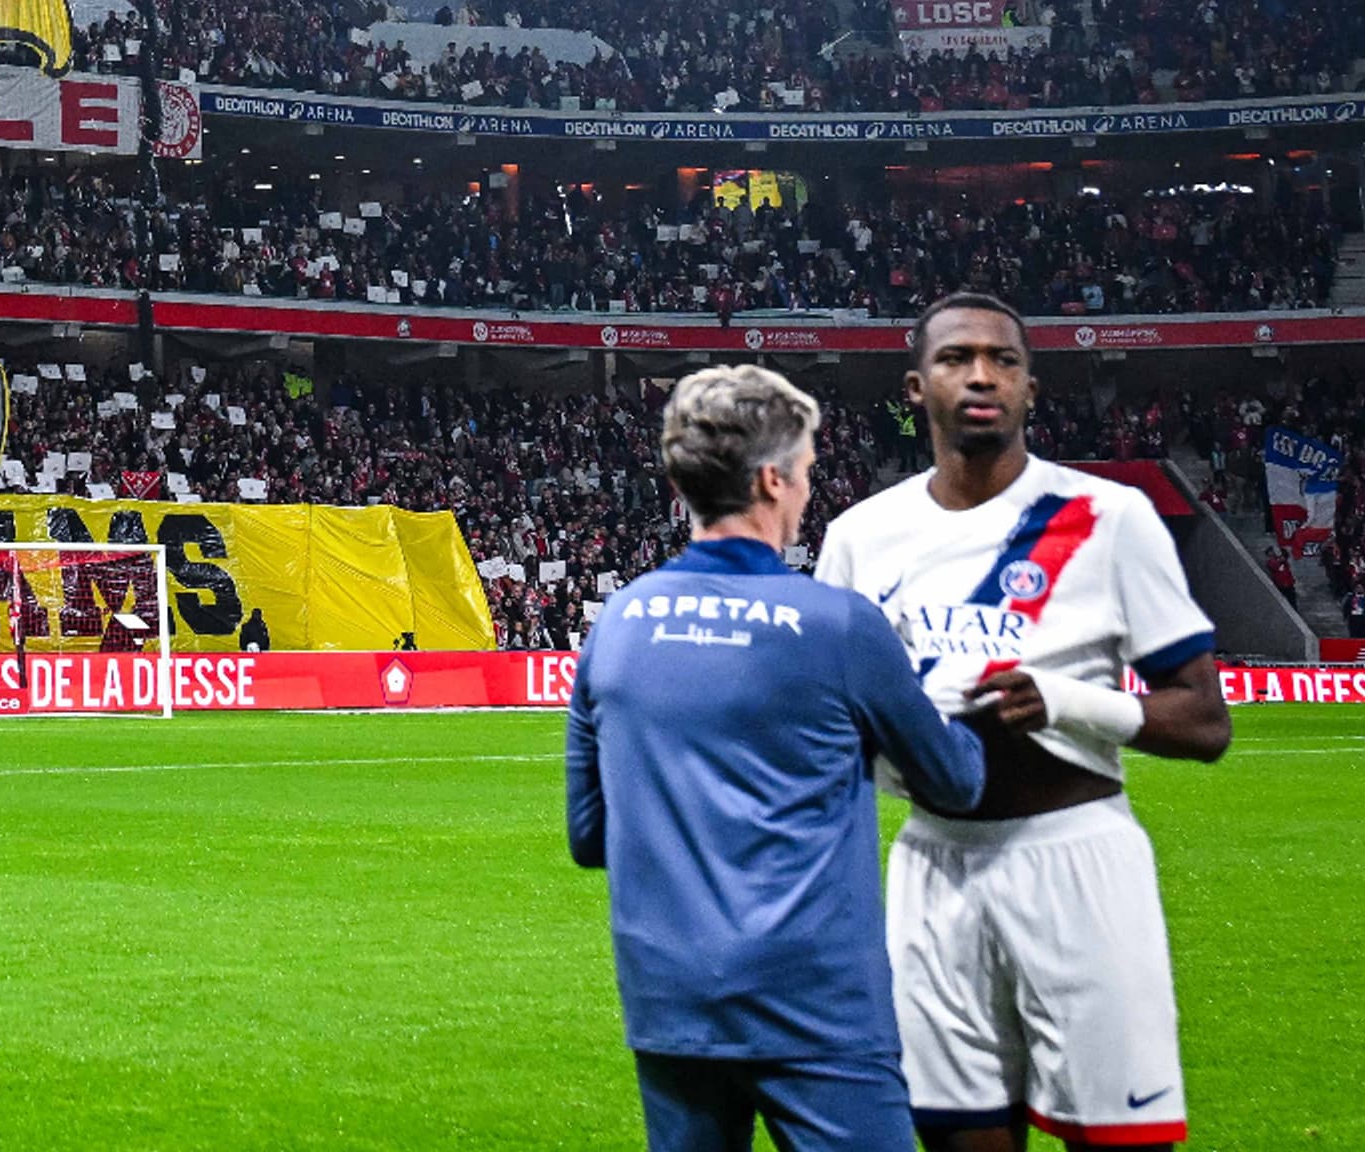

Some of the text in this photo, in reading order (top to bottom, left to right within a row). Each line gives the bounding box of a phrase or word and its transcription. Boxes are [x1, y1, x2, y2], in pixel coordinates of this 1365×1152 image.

[916, 1, 993, 24] LOSC
[215, 96, 355, 123] DECATHLON ARENA
[1227, 105, 1328, 126] DECATHLON
[382, 111, 533, 134] DECATHLON ARENA
[564, 121, 735, 138] DECATHLON ARENA
[769, 122, 956, 138] DECATHLON ARENA
[991, 114, 1189, 136] DECATHLON ARENA
[622, 595, 803, 636] ASPETAR
[31, 657, 75, 709] DE
[82, 656, 126, 708] LA
[526, 657, 578, 703] LES
[1244, 671, 1286, 703] LA
